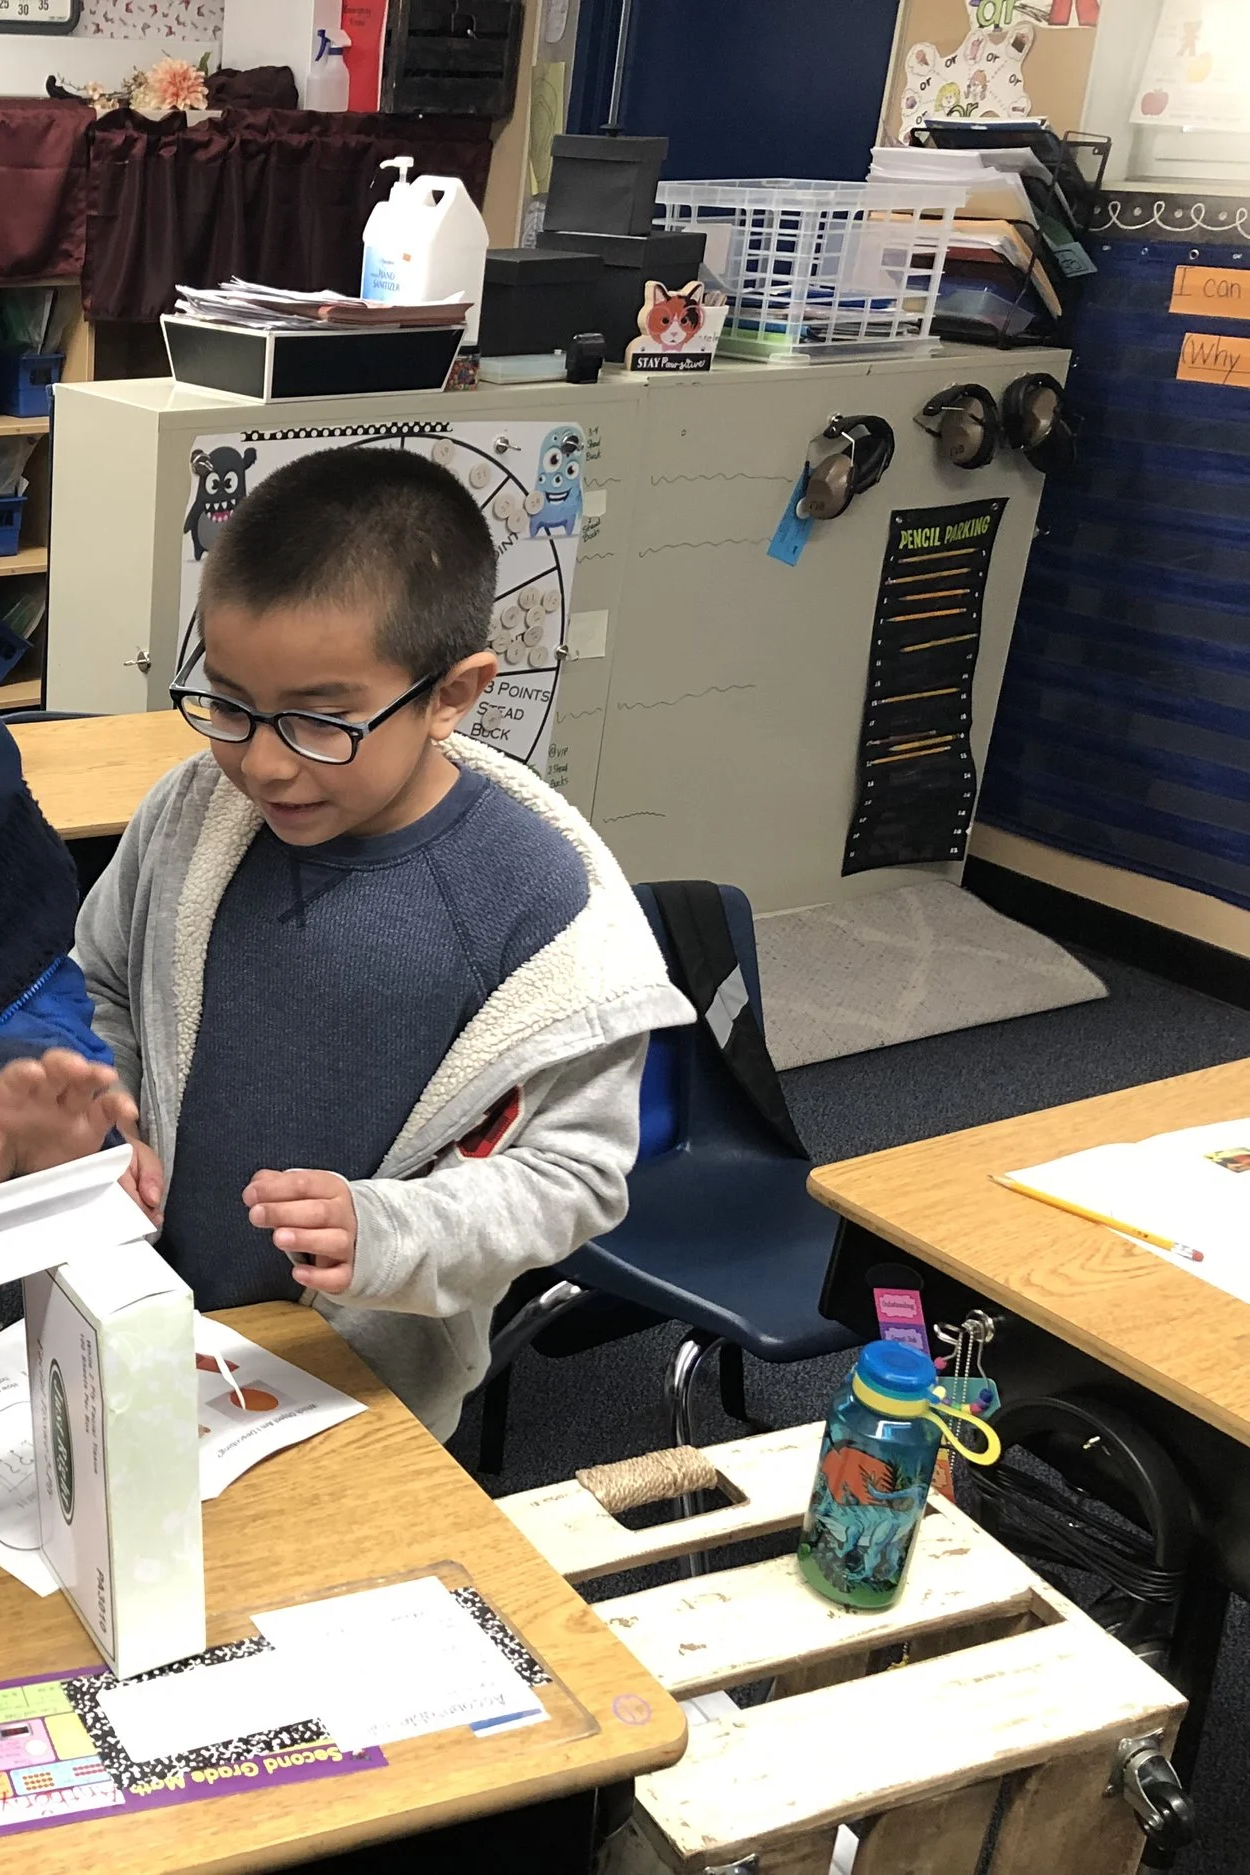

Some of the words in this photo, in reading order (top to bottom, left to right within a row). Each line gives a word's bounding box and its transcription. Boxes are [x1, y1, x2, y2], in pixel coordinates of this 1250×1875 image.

[0, 0, 9, 9] 25
[18, 4, 29, 16] 30
[38, 0, 49, 11] 35
[945, 55, 958, 68] or
[986, 52, 1000, 63] or
[920, 77, 932, 91] or
[1009, 73, 1022, 86] or
[1174, 267, 1194, 296] I
[1203, 279, 1241, 299] can
[637, 357, 661, 368] STAY
[898, 527, 941, 550] PENCIL
[943, 515, 991, 545] PARKING
[498, 682, 551, 703] POINTS
[470, 722, 511, 740] BUCK
[53, 1380, 66, 1430] Just
[261, 1420, 274, 1429] Am
[56, 1437, 72, 1506] Right
[96, 1567, 107, 1633] PA3010
[263, 1746, 343, 1774] Second
[190, 1761, 259, 1785] Grade
[129, 1771, 185, 1797] Math
